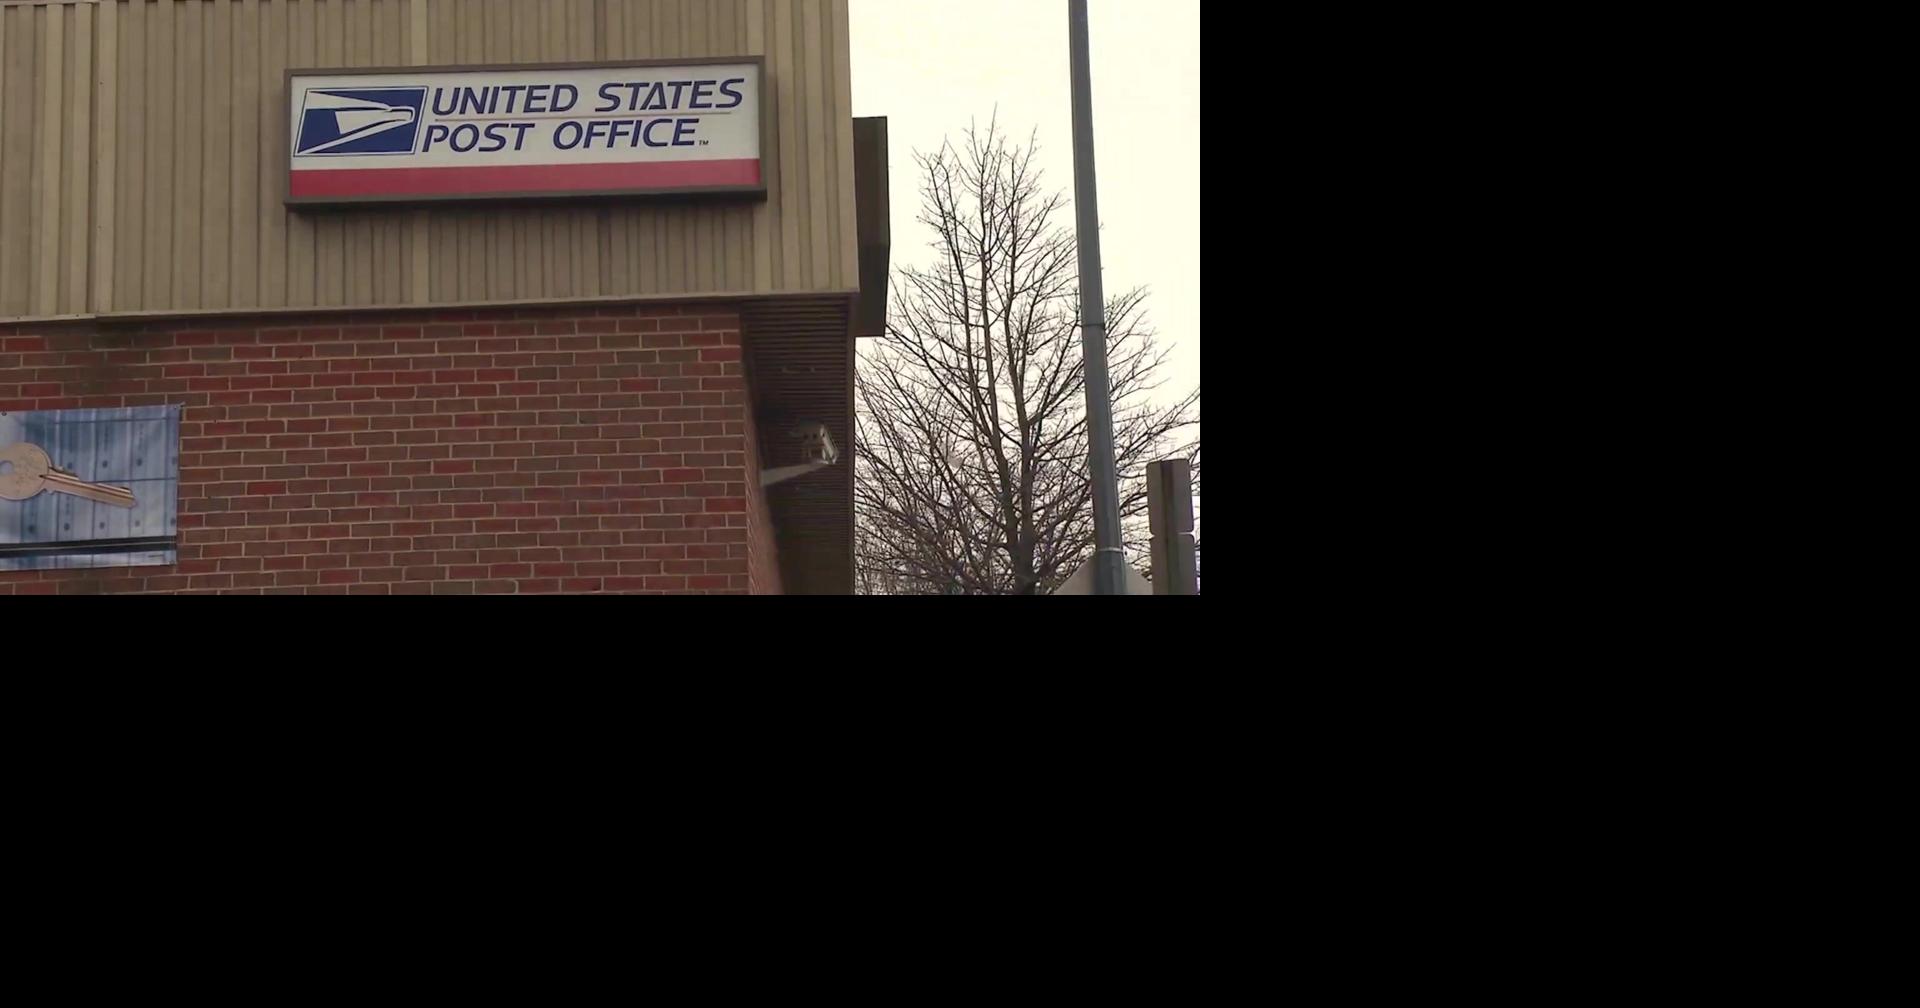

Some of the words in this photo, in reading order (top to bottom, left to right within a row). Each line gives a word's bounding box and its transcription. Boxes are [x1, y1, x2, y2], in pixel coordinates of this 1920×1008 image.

[431, 83, 579, 117] UNITED
[594, 77, 745, 113] STATES
[422, 121, 536, 153] POST
[552, 117, 700, 151] OFFICE
